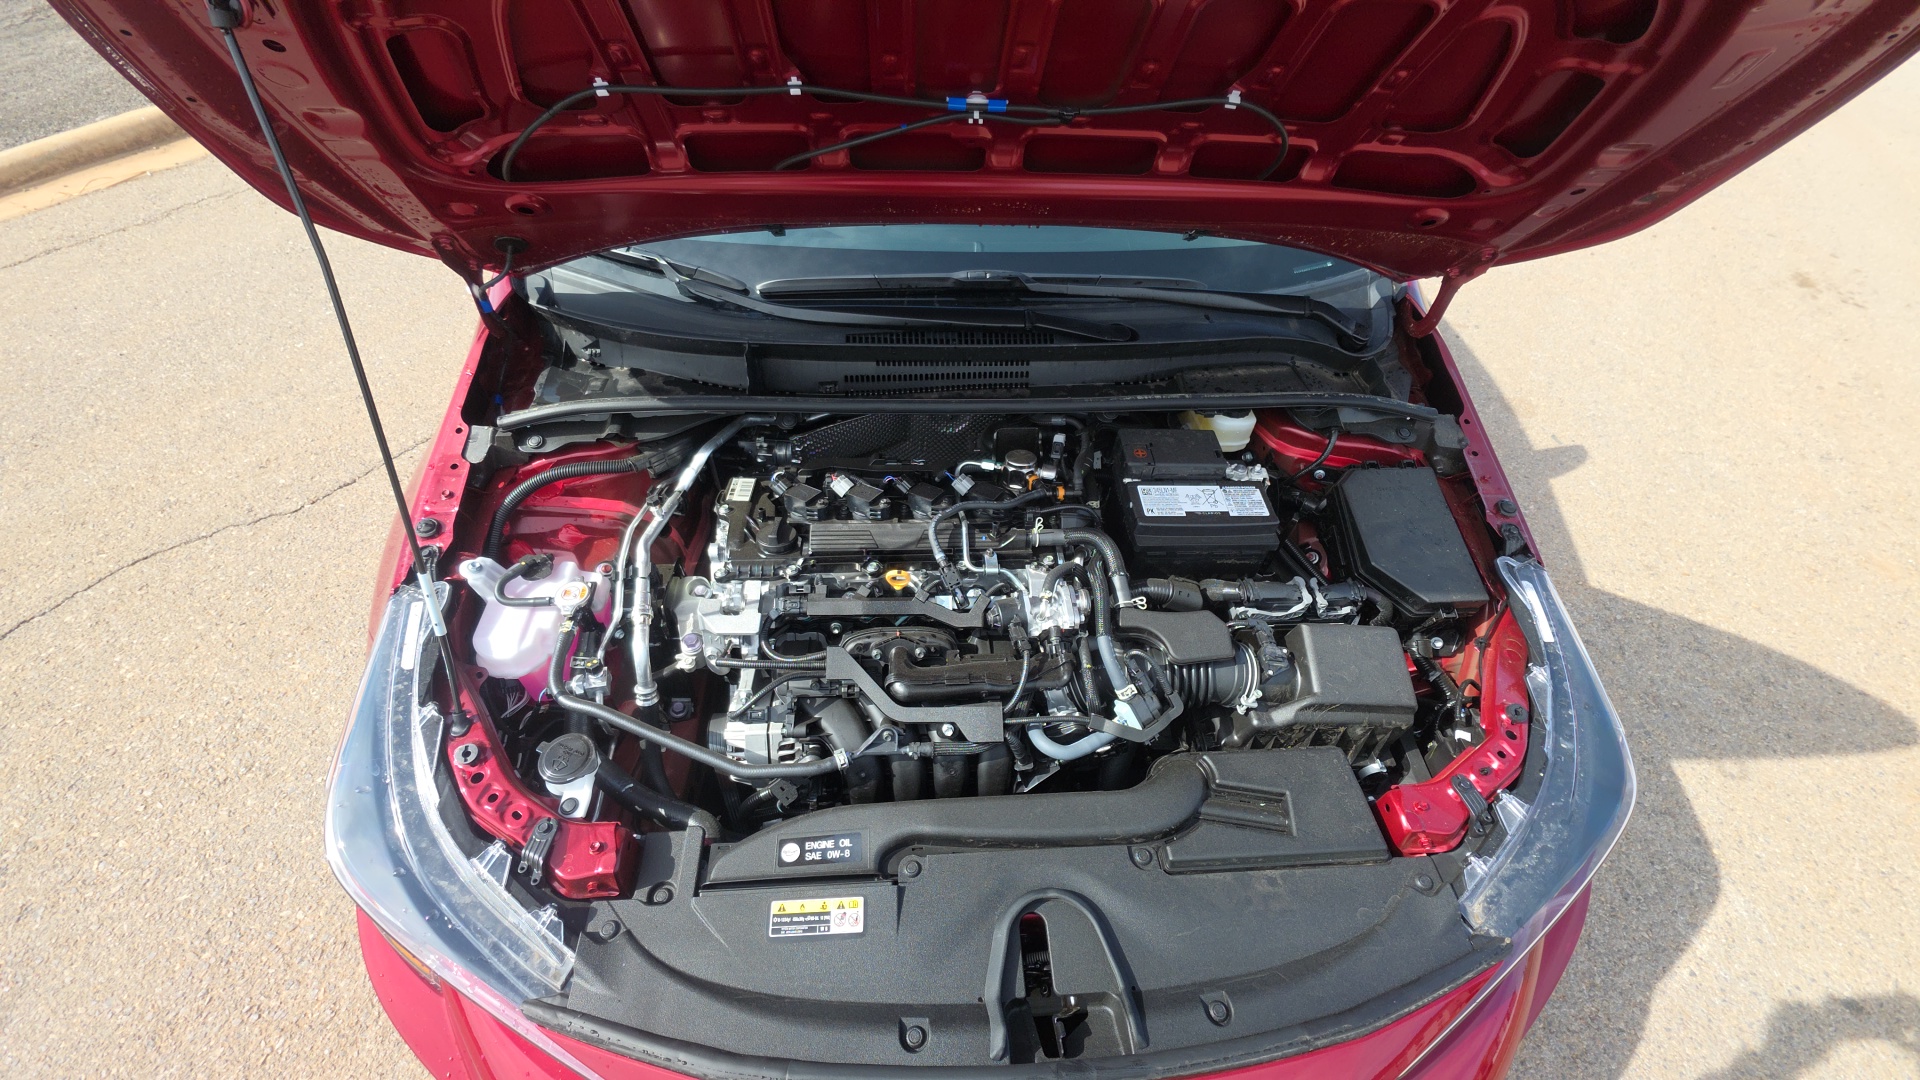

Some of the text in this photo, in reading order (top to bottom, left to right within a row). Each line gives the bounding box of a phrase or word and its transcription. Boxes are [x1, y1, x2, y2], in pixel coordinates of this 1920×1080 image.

[805, 839, 852, 850] ENGINE OIL
[805, 849, 851, 861] SAE 0W-8
